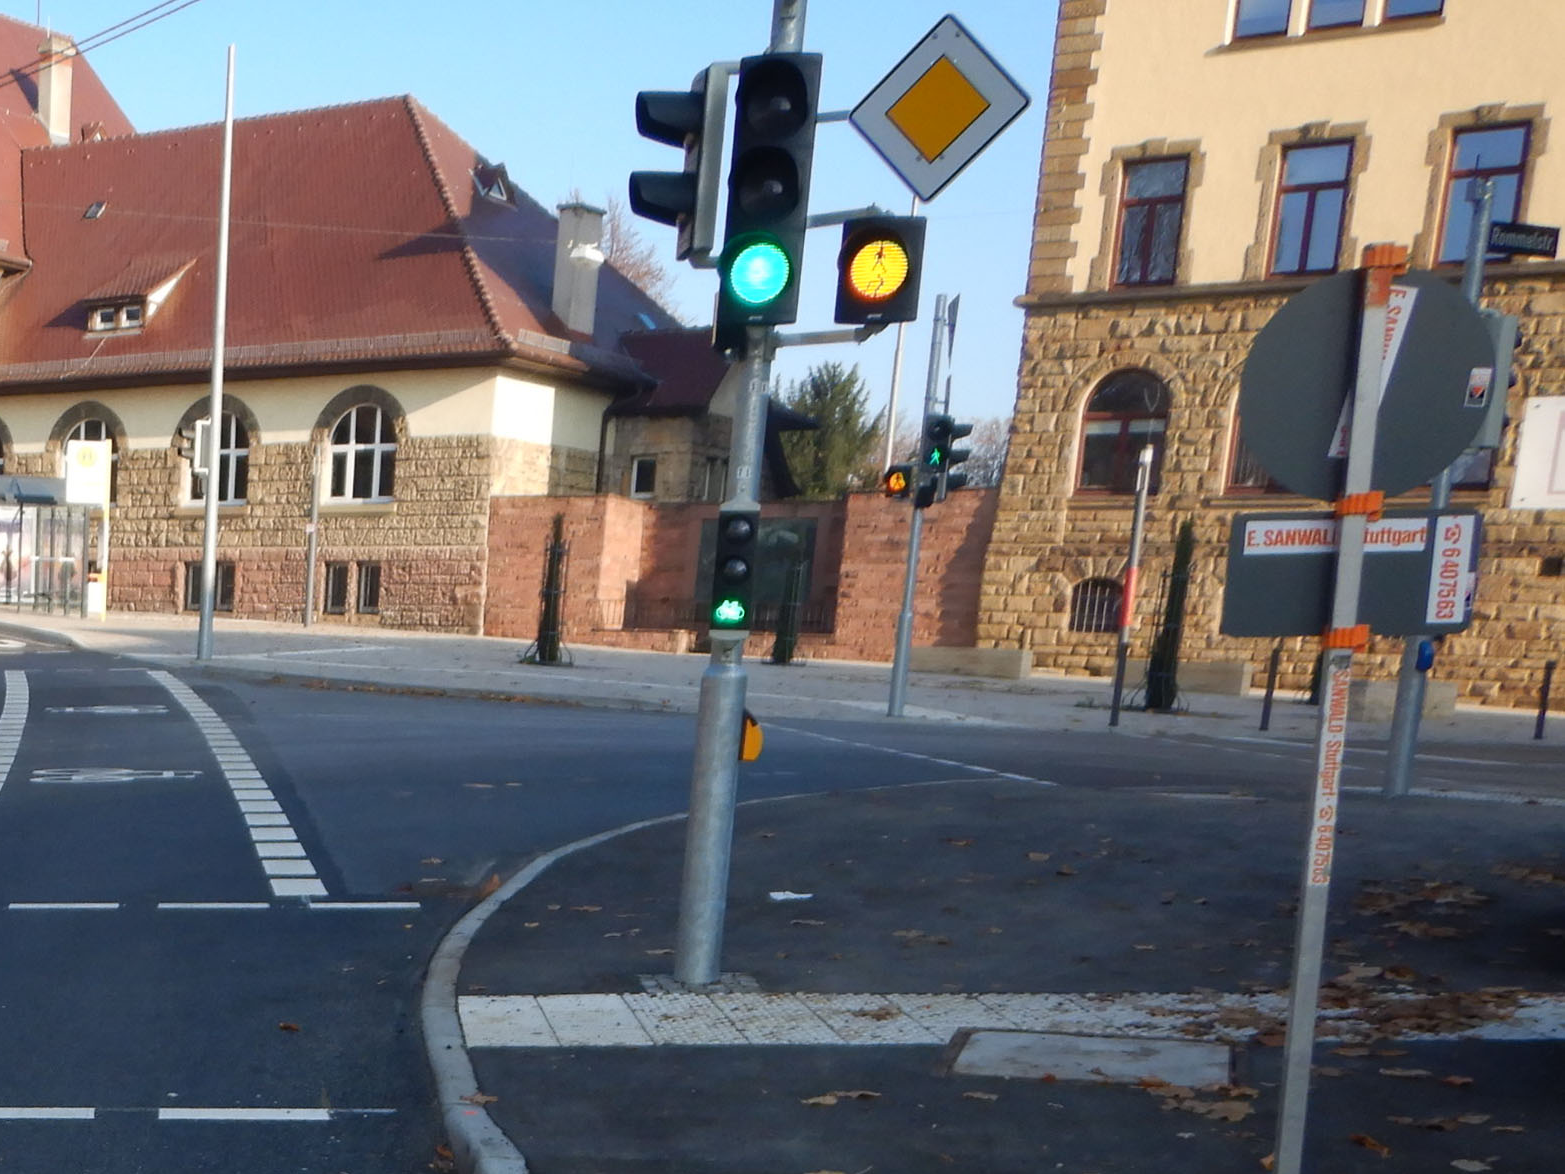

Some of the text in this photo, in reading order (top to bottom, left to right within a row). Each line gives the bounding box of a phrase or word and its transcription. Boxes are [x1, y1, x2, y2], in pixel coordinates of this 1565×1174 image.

[1247, 526, 1427, 547] E. SANWAL tuttgart
[1327, 668, 1350, 733] SANWALD
[1319, 739, 1342, 797] Stuttgart
